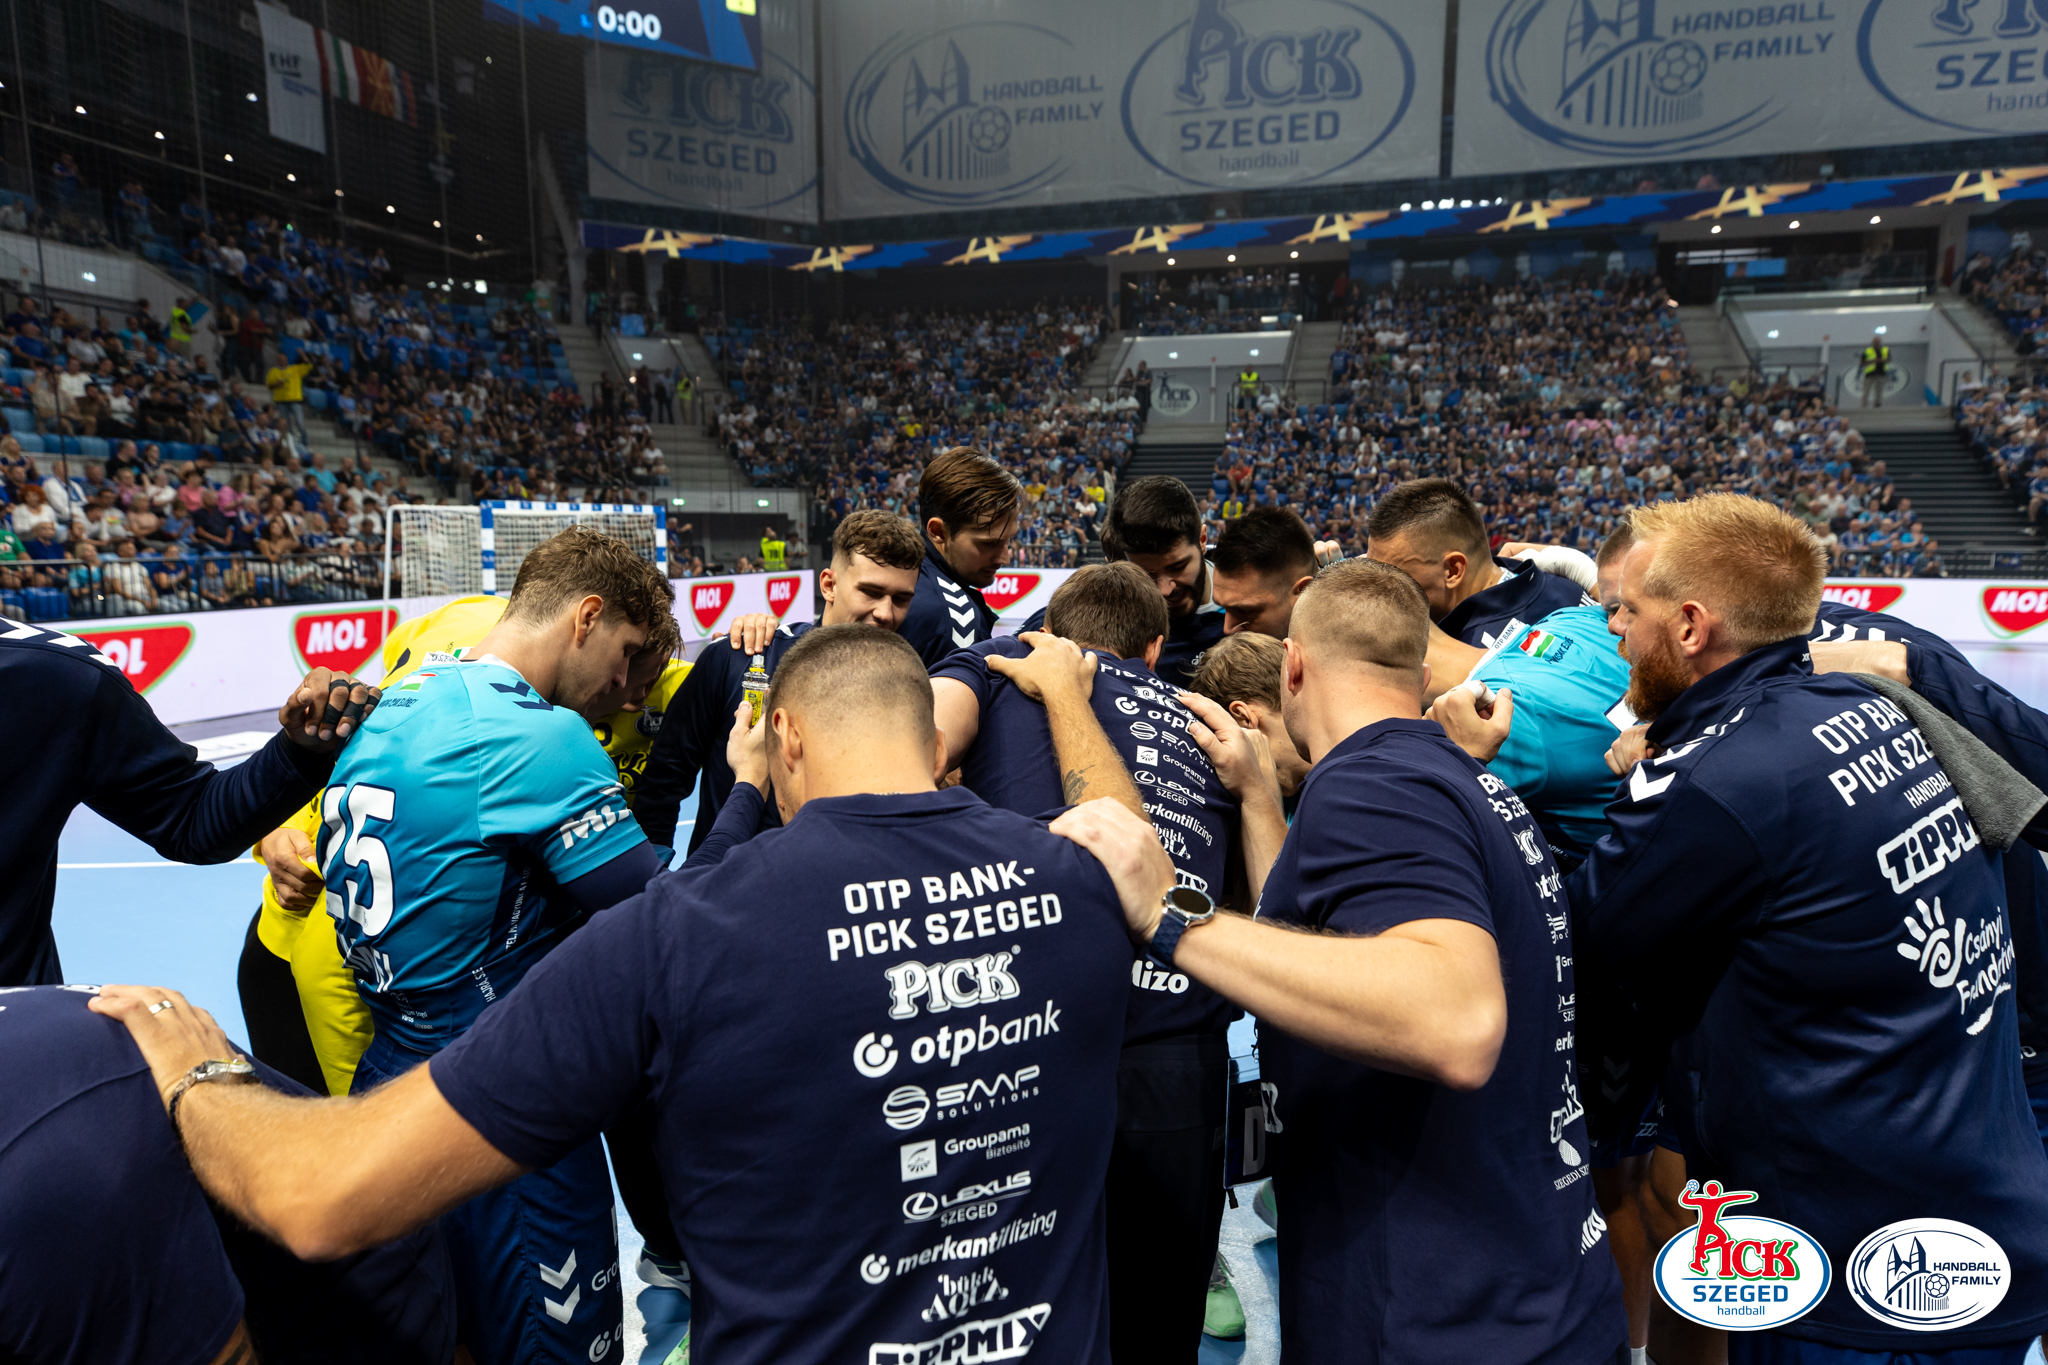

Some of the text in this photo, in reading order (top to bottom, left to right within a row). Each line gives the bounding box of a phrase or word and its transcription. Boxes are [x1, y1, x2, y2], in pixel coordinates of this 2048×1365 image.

[597, 4, 662, 41] 0:00
[1672, 2, 1836, 36] HANDBALL
[1713, 32, 1834, 62] FAMILY
[982, 73, 1103, 101] HANDBALL
[1987, 91, 2048, 112] hand
[1015, 102, 1104, 126] FAMILY
[1180, 110, 1340, 152] SZEGED
[626, 127, 777, 176] SZEGED
[1218, 149, 1300, 171] handball
[667, 167, 743, 193] handball
[694, 587, 721, 609] MOL
[769, 581, 790, 601] MOL
[1990, 590, 2048, 613] MOL
[306, 617, 368, 656] MOL
[94, 637, 147, 675] OL
[1811, 710, 1870, 755] OTP
[1162, 754, 1206, 785] Groupama
[1827, 745, 1903, 807] PICK
[1156, 788, 1188, 807] SZEGED
[1157, 777, 1206, 806] LEXUS
[1141, 803, 1213, 847] erkantillízing
[1158, 835, 1191, 860] QUA
[843, 860, 1035, 915] OTP BANK-
[827, 893, 1062, 961] PICK SZEGED
[1965, 906, 2004, 966] Csányi
[884, 951, 1021, 1020] PICK
[910, 999, 1061, 1067] otpbank
[936, 1065, 1040, 1107] SMP
[937, 1086, 1039, 1120] SOLUTIONS
[944, 1123, 1030, 1155] Groupama
[985, 1138, 1031, 1160] Biztosító
[941, 1170, 1032, 1206] LEXUS
[940, 1202, 998, 1227] SZEGED
